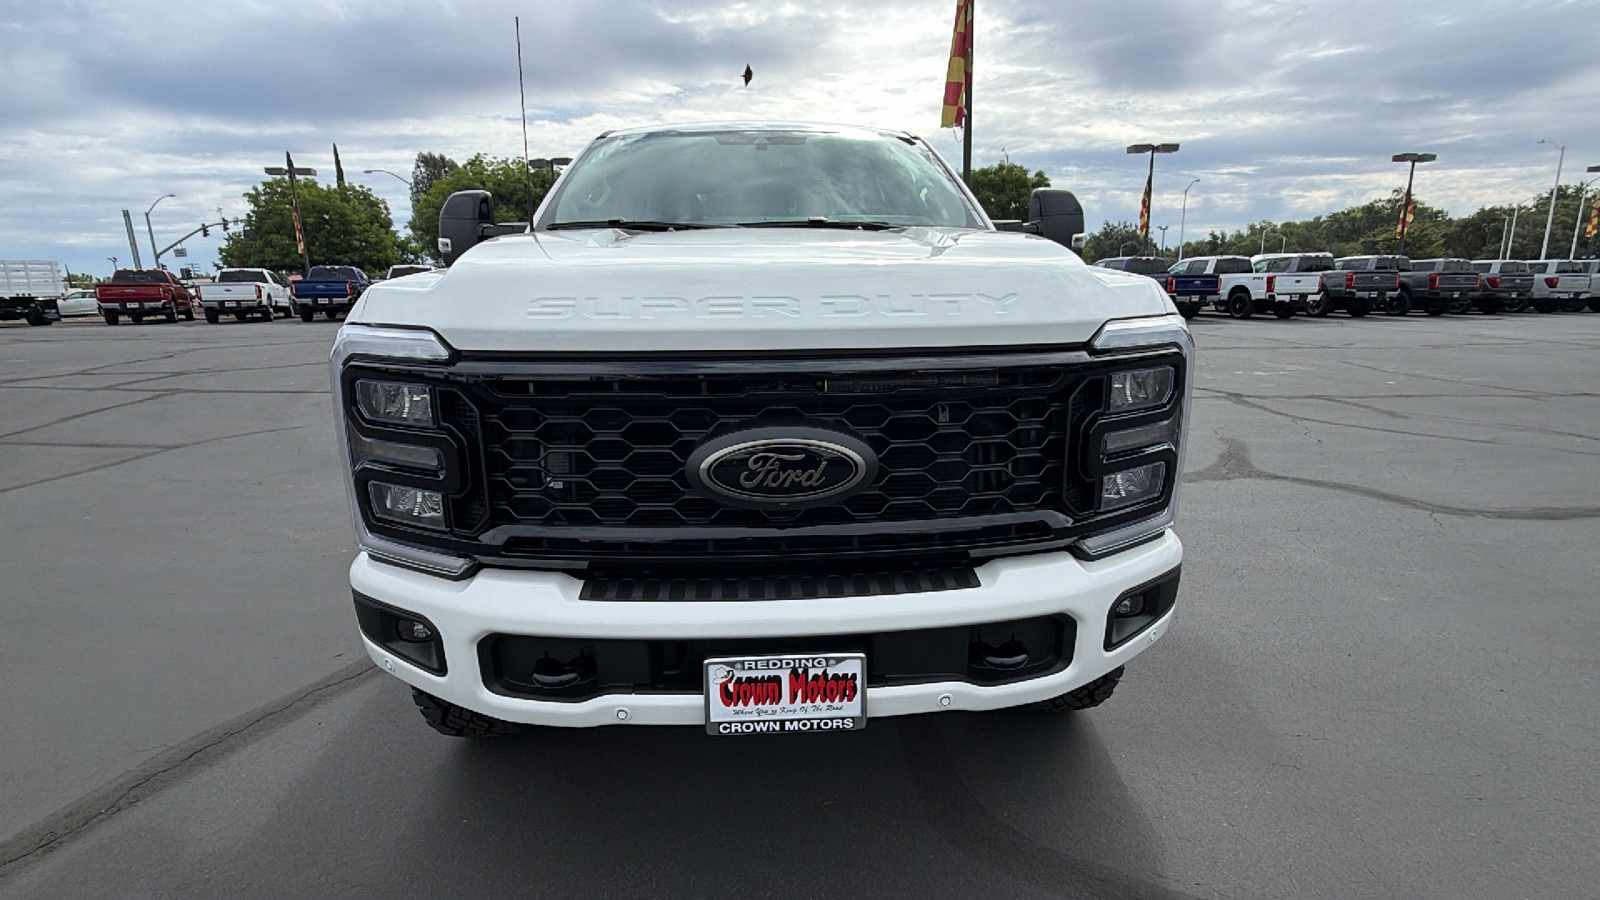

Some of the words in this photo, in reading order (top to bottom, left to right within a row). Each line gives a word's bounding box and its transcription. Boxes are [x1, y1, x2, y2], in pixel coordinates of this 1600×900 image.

[526, 296, 801, 319] SUPER
[820, 292, 1018, 317] DUTY
[739, 452, 828, 488] Ford
[744, 658, 827, 670] REDDING
[719, 670, 782, 708] Crown
[788, 668, 858, 705] Motors
[732, 708, 754, 716] Where
[779, 706, 797, 715] King
[810, 704, 823, 712] The
[824, 704, 844, 712] Road
[719, 721, 780, 734] CROWN
[784, 718, 854, 731] MOTORS
